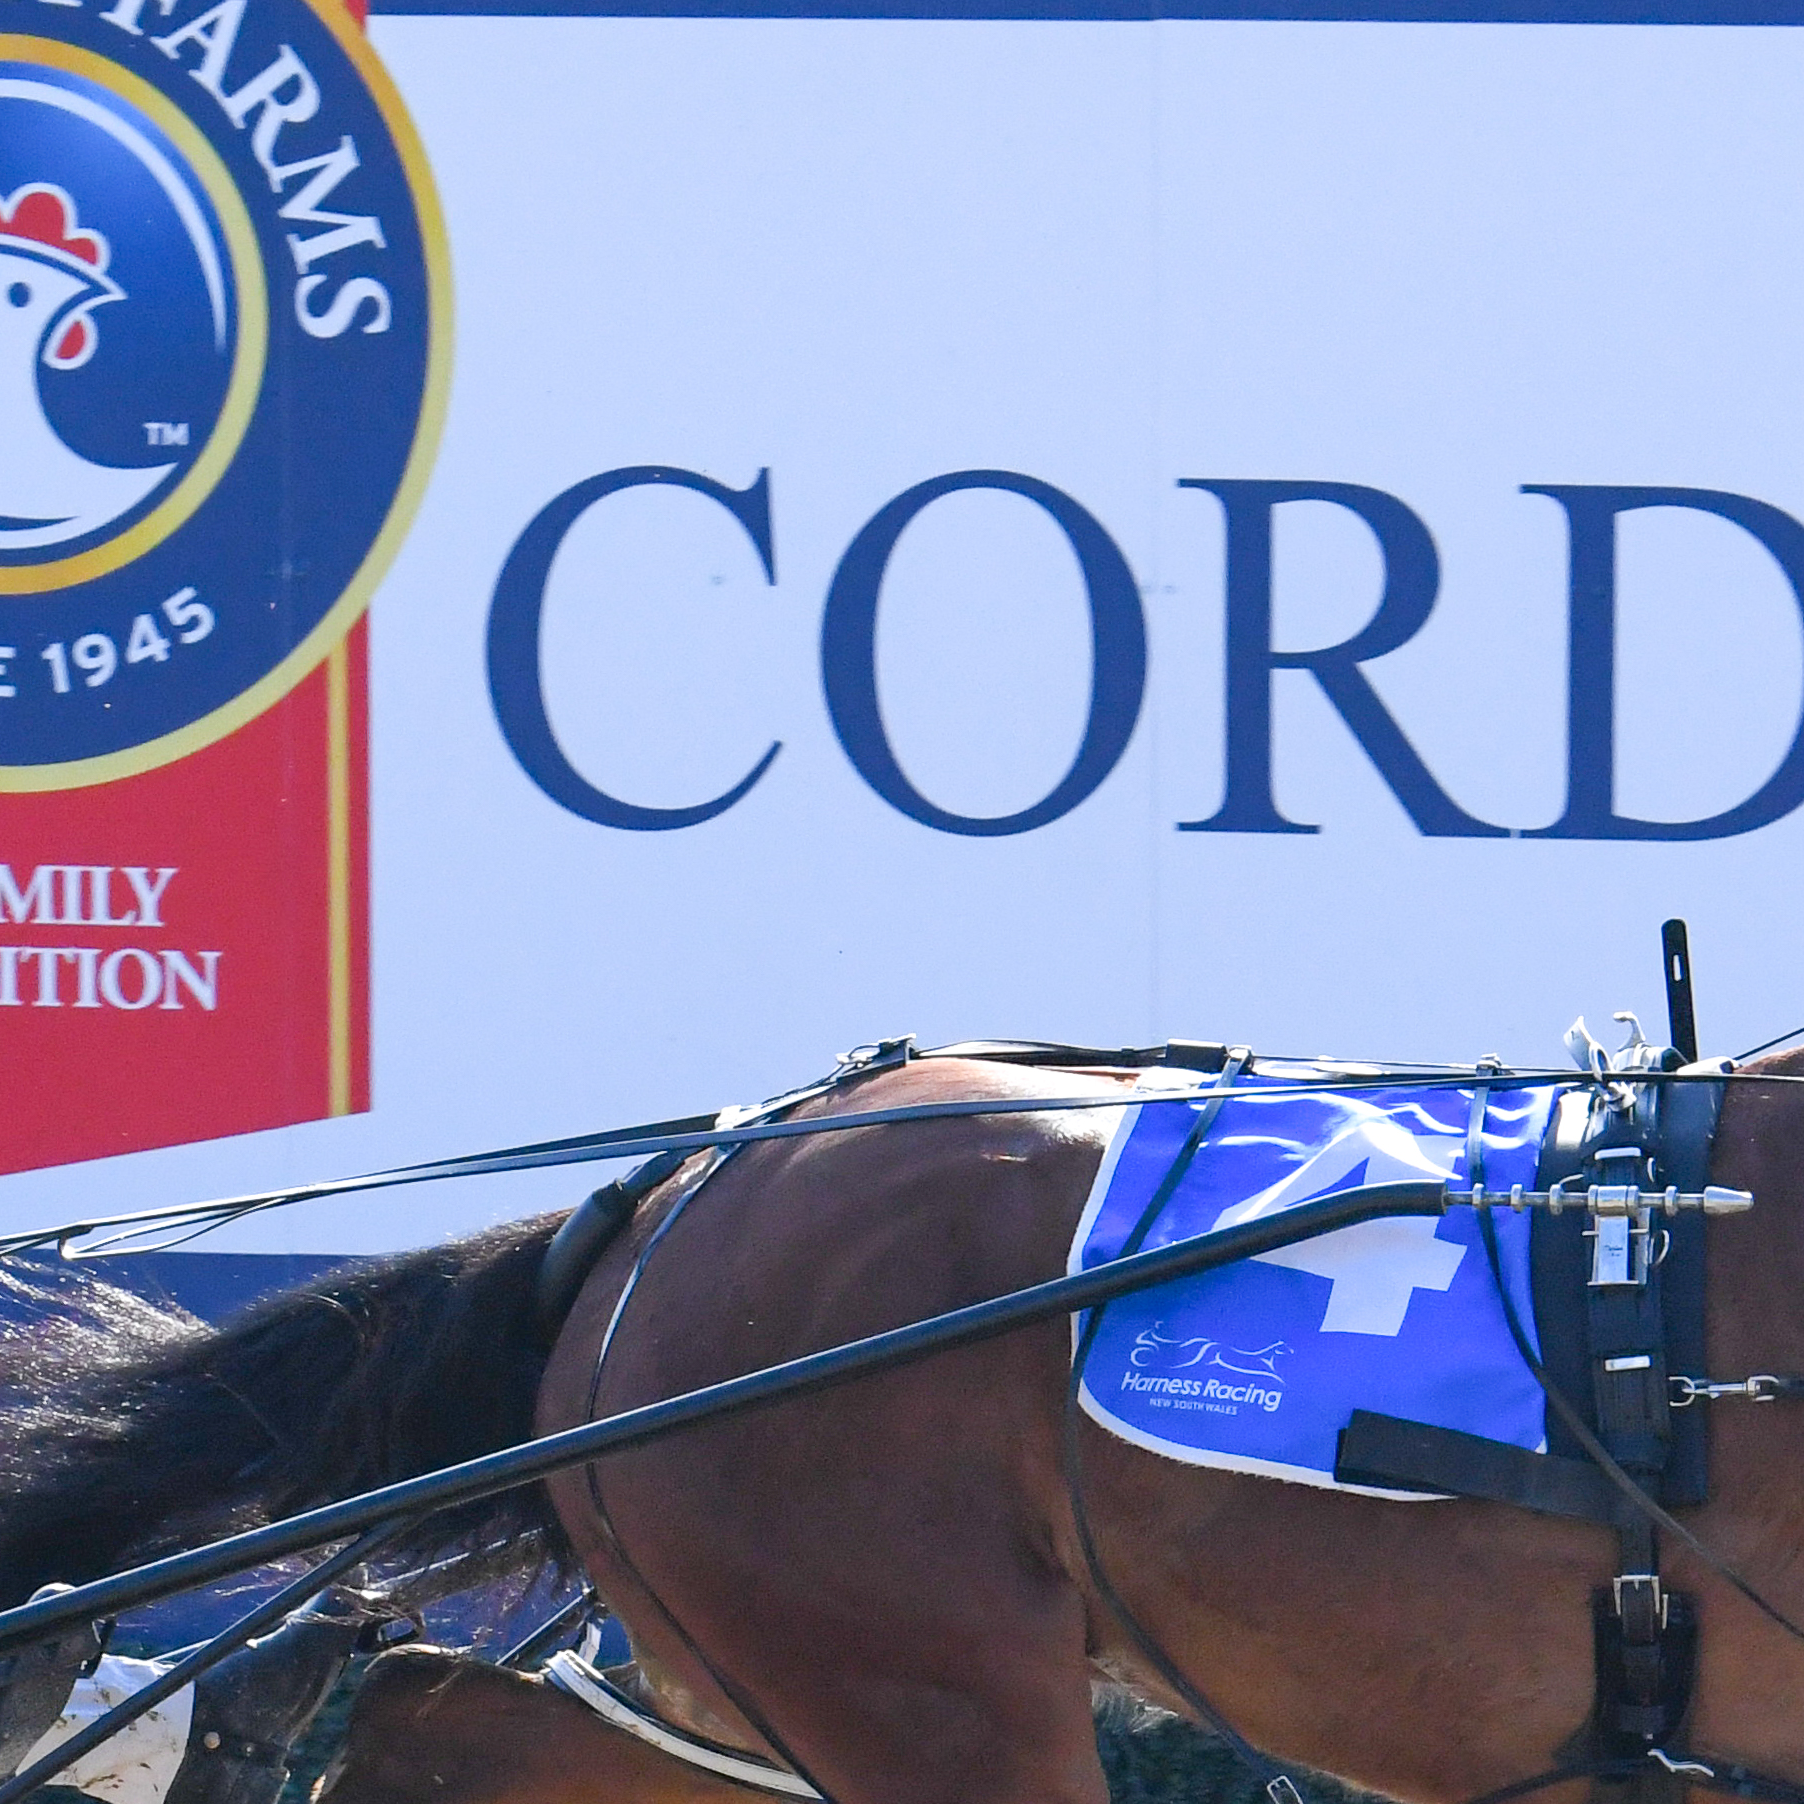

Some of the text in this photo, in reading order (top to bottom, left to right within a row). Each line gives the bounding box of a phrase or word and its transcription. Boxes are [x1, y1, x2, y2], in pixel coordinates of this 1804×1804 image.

[143, 422, 188, 446] TM
[42, 585, 216, 694] 1945
[1210, 1122, 1469, 1337] 4
[1120, 1370, 1283, 1412] Harness Racing
[1149, 1397, 1239, 1416] NEW SOUTH WALES
